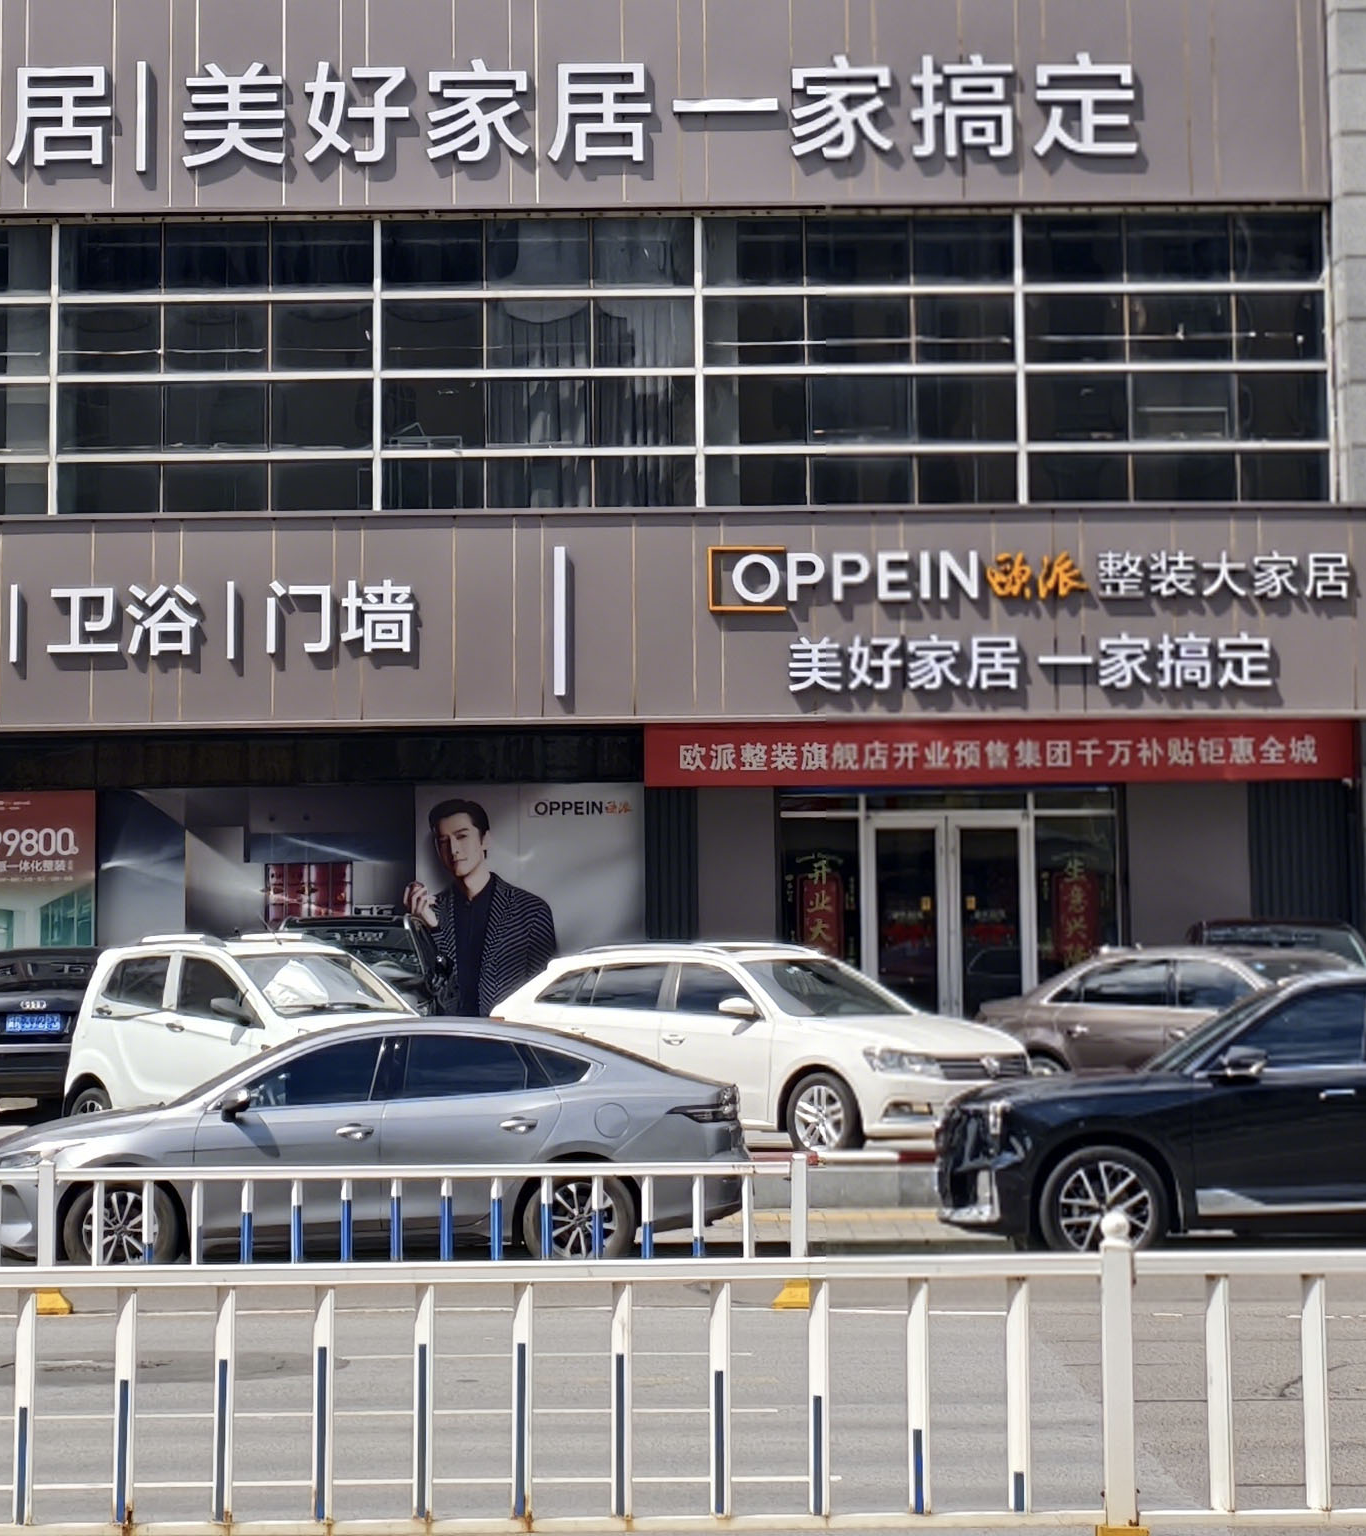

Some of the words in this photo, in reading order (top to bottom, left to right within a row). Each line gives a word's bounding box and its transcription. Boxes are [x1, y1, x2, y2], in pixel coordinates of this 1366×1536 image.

[182, 51, 1140, 166] 美好家居一家搞定
[731, 548, 979, 603] OPPEIN
[1098, 550, 1351, 599] 整装大家居
[46, 583, 200, 656] 卫浴
[266, 578, 415, 654] 门墙
[678, 734, 1318, 772] 欧派整装旗舰店开业预售集团千万补贴钜惠全城
[534, 801, 603, 816] OPPEIN
[807, 860, 833, 946] 开业大
